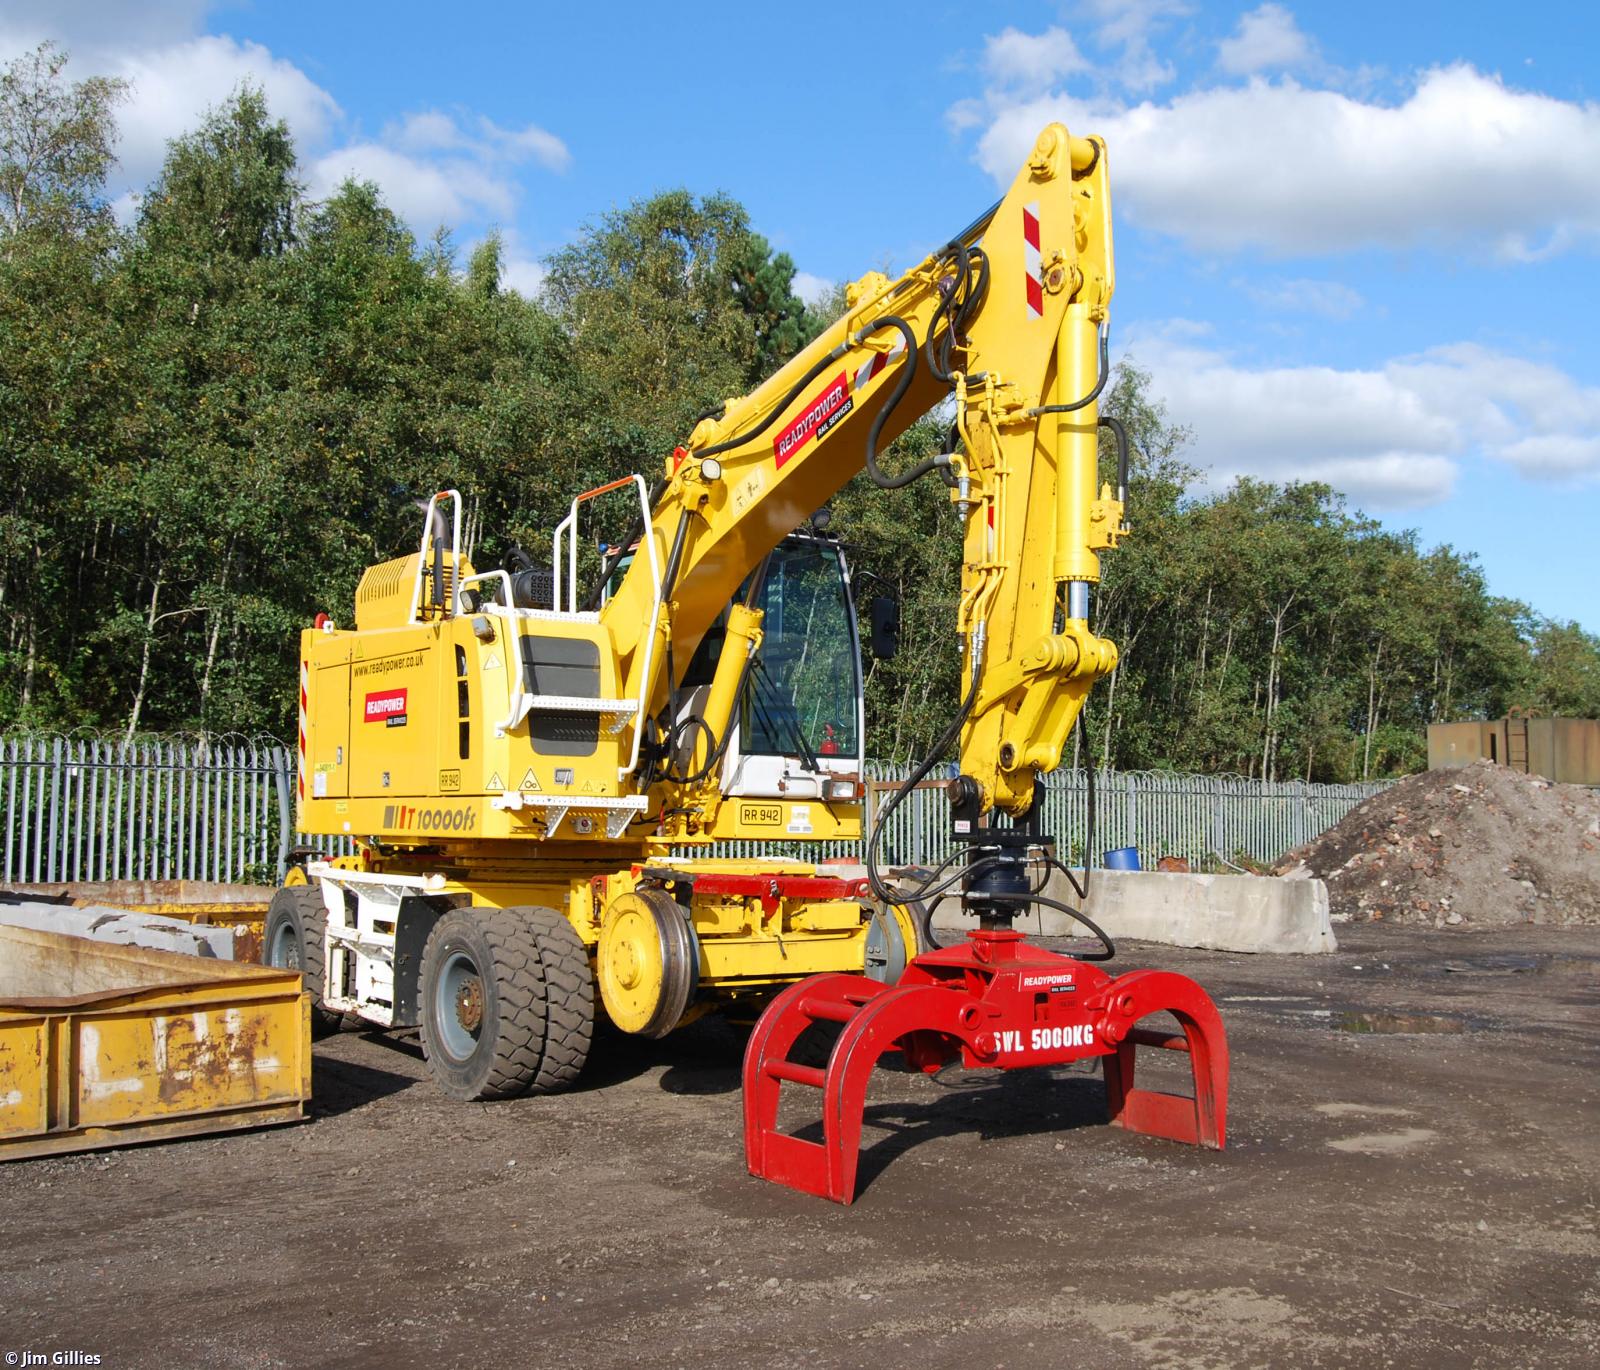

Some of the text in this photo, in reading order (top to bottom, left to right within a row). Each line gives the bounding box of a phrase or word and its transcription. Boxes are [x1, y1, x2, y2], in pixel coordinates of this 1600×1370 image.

[779, 386, 842, 456] READYPOWER
[817, 400, 852, 436] RAIL SERVICES
[354, 654, 424, 677] www.readypower.co.uk
[367, 697, 404, 714] READYPOWER
[744, 809, 779, 821] RR 942
[1024, 974, 1072, 986] READYPOWER
[993, 1024, 1094, 1053] SWL 5000KG
